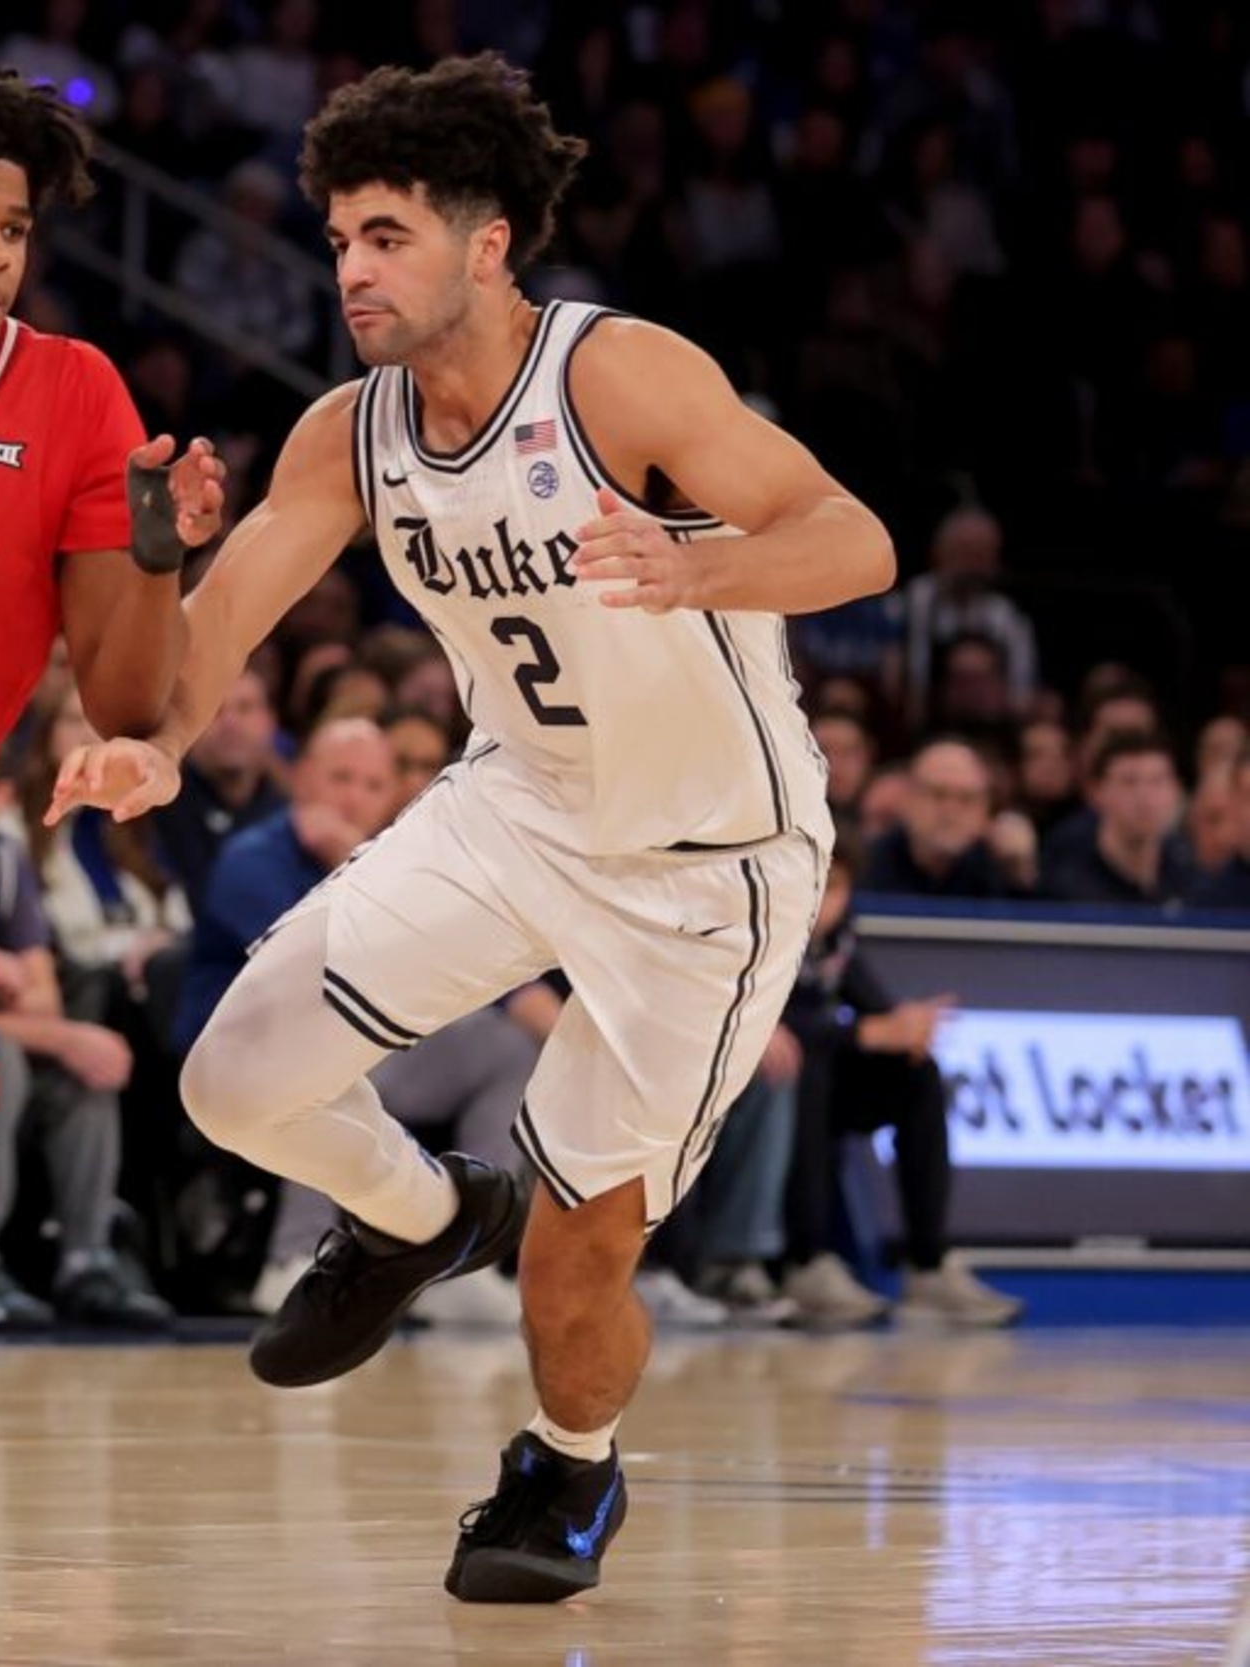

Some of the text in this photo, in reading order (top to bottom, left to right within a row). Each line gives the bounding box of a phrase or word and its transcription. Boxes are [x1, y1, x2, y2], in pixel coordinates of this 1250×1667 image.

[392, 516, 581, 600] Duke
[490, 616, 588, 726] 2
[941, 1046, 1020, 1132] ot
